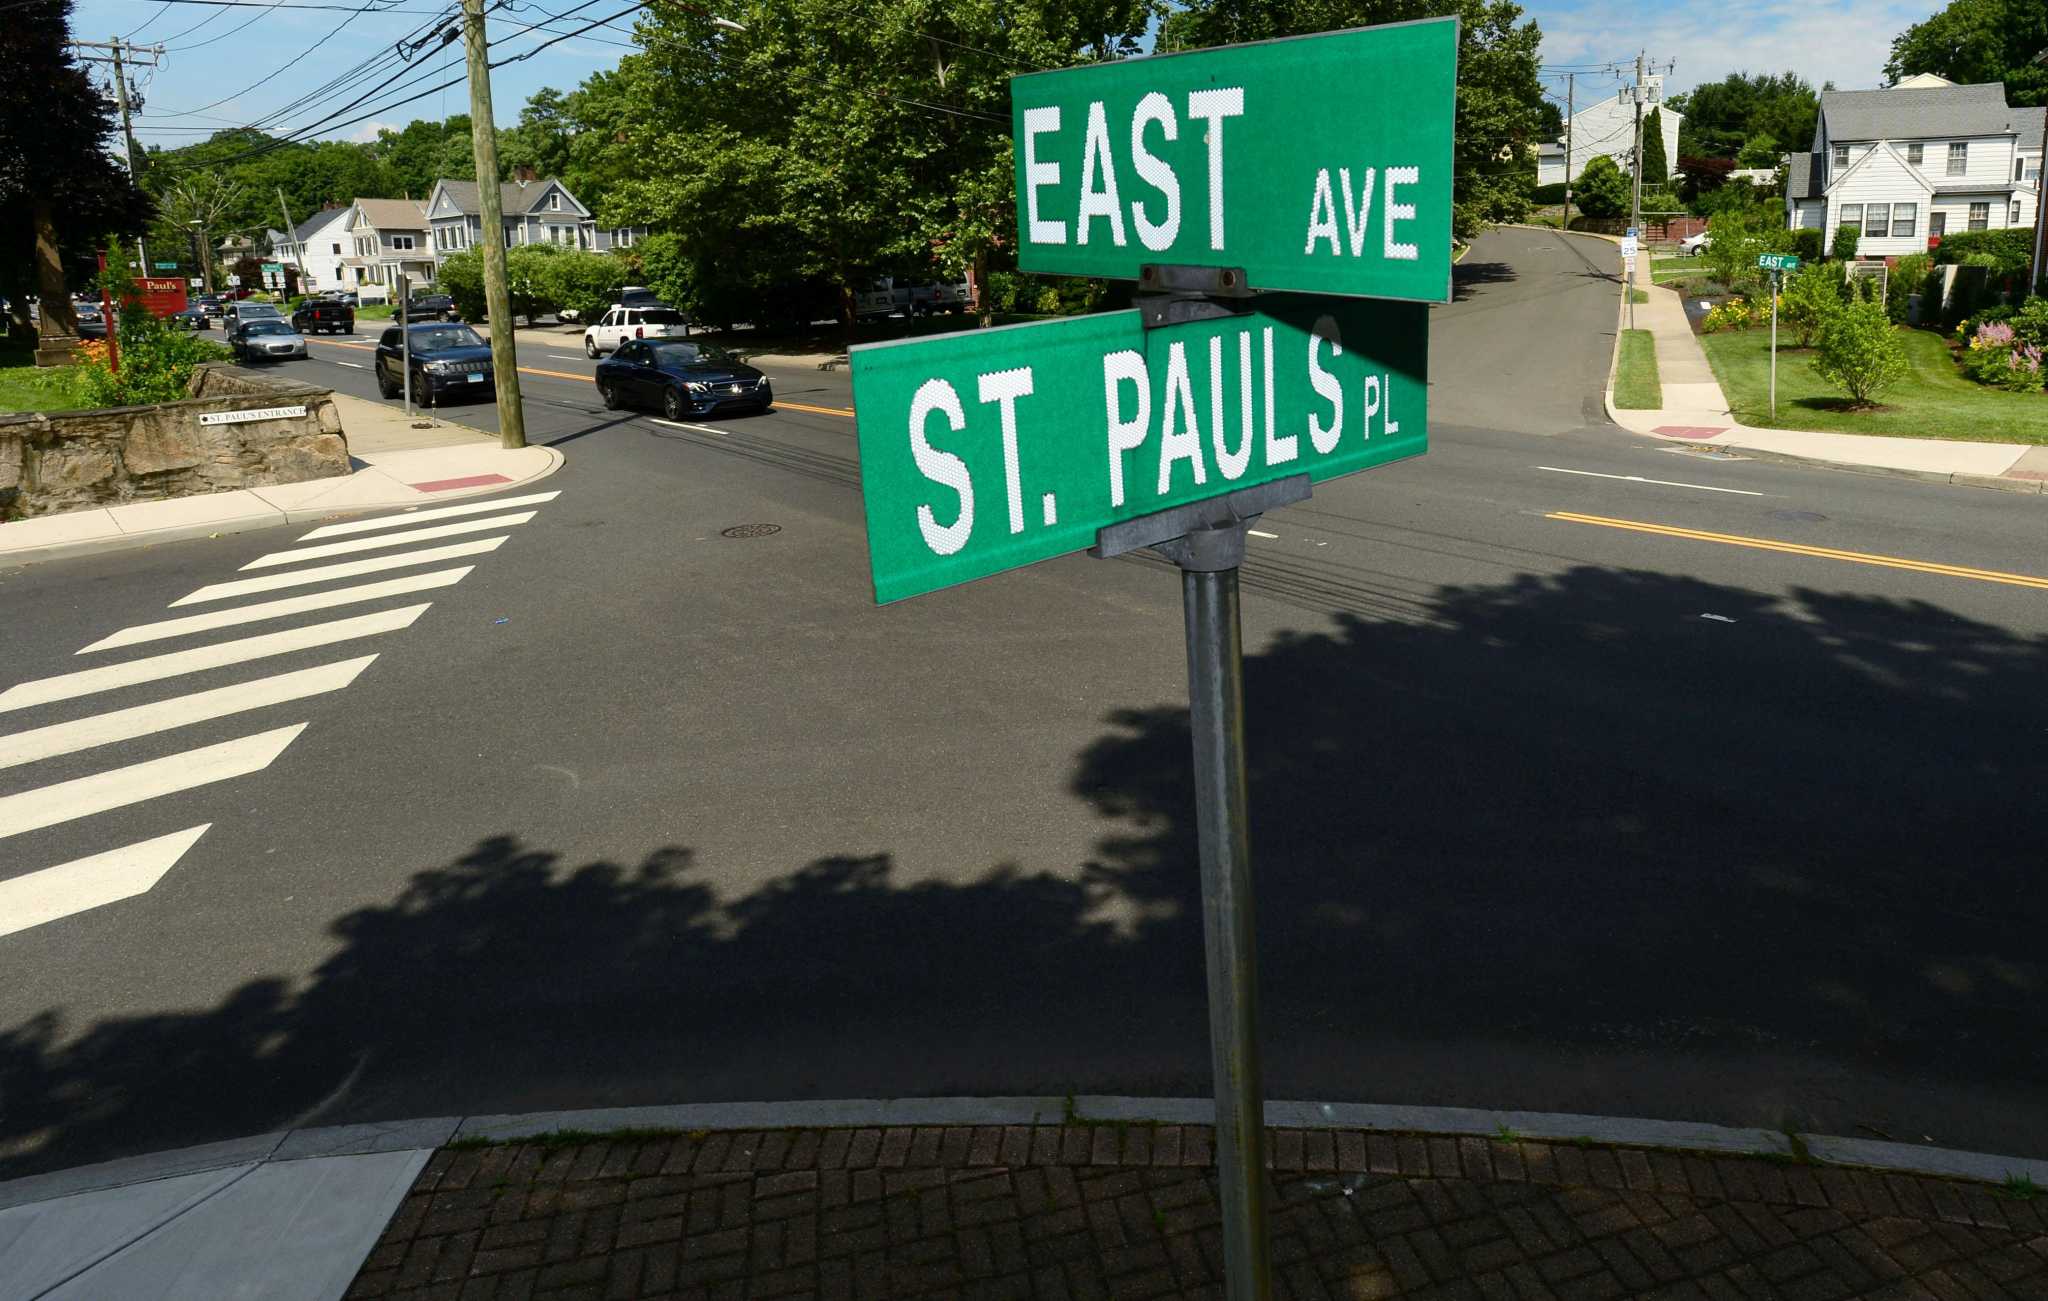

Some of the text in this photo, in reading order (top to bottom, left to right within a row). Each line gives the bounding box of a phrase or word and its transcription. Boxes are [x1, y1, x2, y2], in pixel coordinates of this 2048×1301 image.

[1023, 86, 1419, 260] EAST AVE
[1623, 247, 1636, 255] 25
[1759, 255, 1784, 269] EAST
[146, 281, 177, 290] Paul's
[257, 407, 305, 417] ENTRANCE
[909, 314, 1400, 556] ST. PAULS PL
